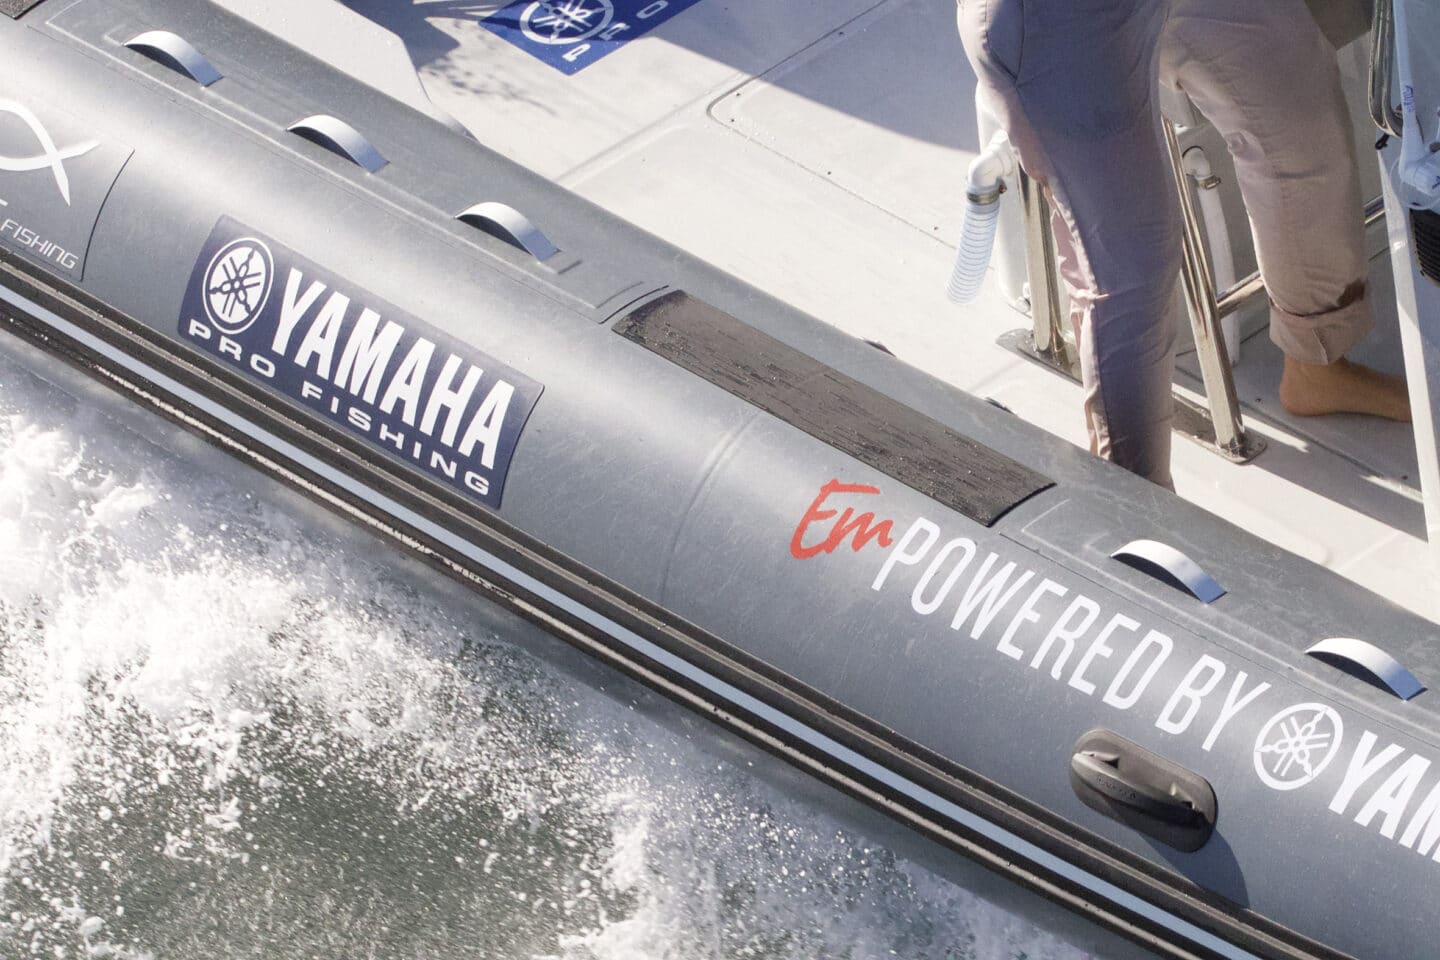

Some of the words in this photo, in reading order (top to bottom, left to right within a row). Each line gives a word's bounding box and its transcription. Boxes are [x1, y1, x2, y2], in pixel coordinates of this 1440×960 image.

[561, 0, 669, 62] PRO
[0, 219, 79, 269] FISHING
[187, 318, 276, 379] PRO
[300, 381, 491, 497] FISHING
[272, 267, 515, 471] YAMAHA
[1154, 654, 1271, 753] BY
